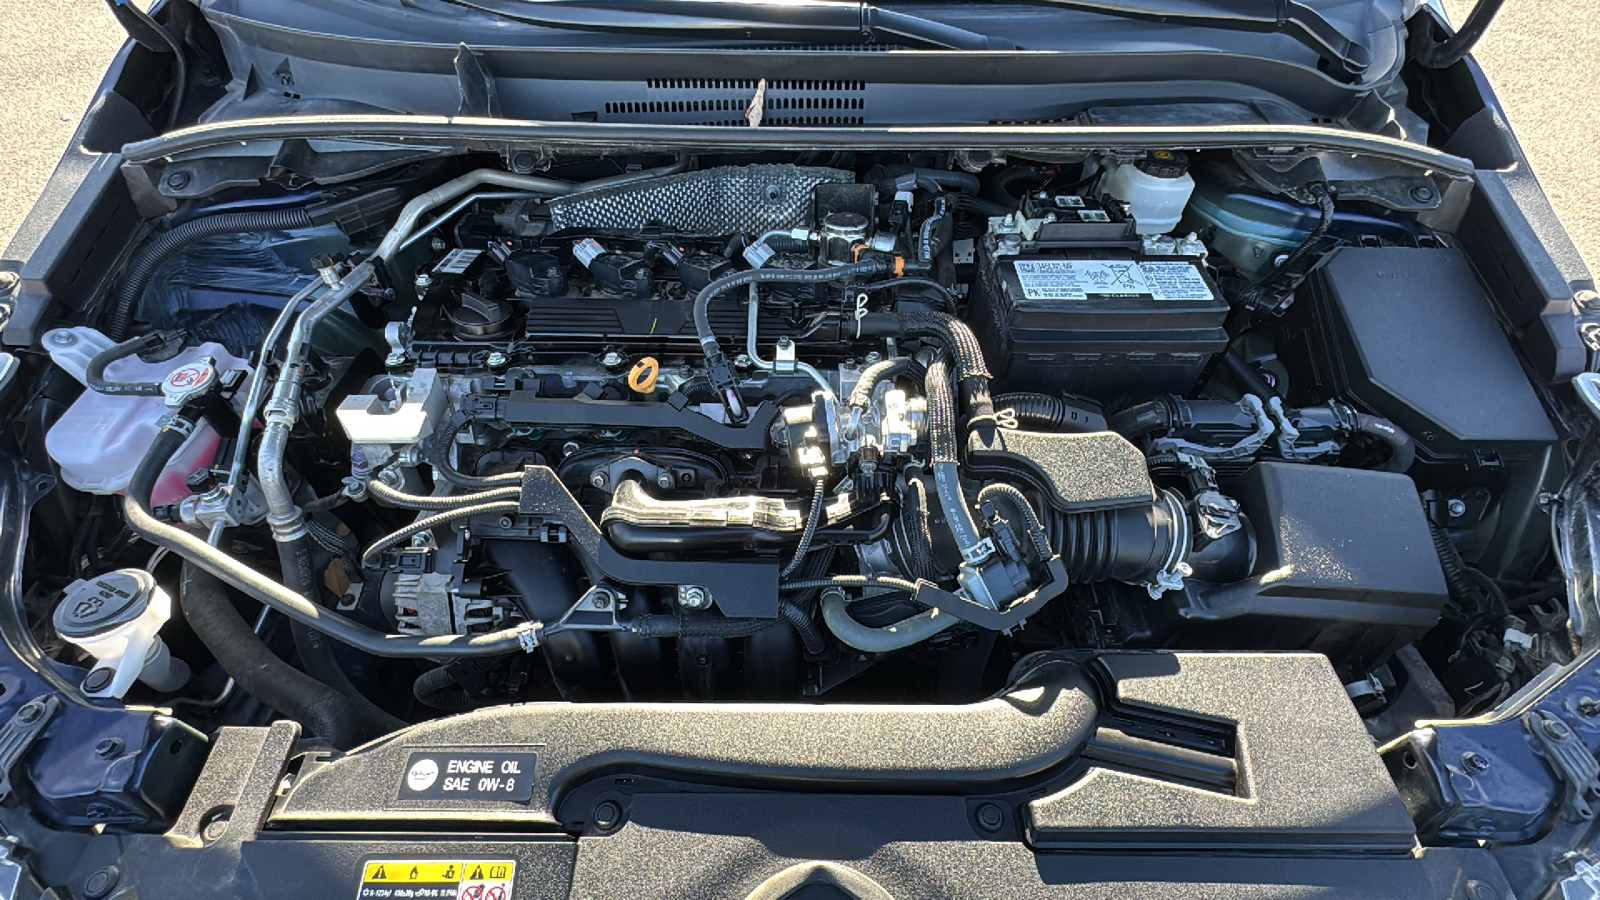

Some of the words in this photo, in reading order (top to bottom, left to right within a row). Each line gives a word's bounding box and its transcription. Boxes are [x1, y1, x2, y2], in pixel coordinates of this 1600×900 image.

[1027, 288, 1041, 297] PK
[446, 760, 495, 774] ENGINE
[501, 760, 522, 774] OIL
[442, 777, 471, 791] SAE
[477, 777, 515, 792] 0W-8
